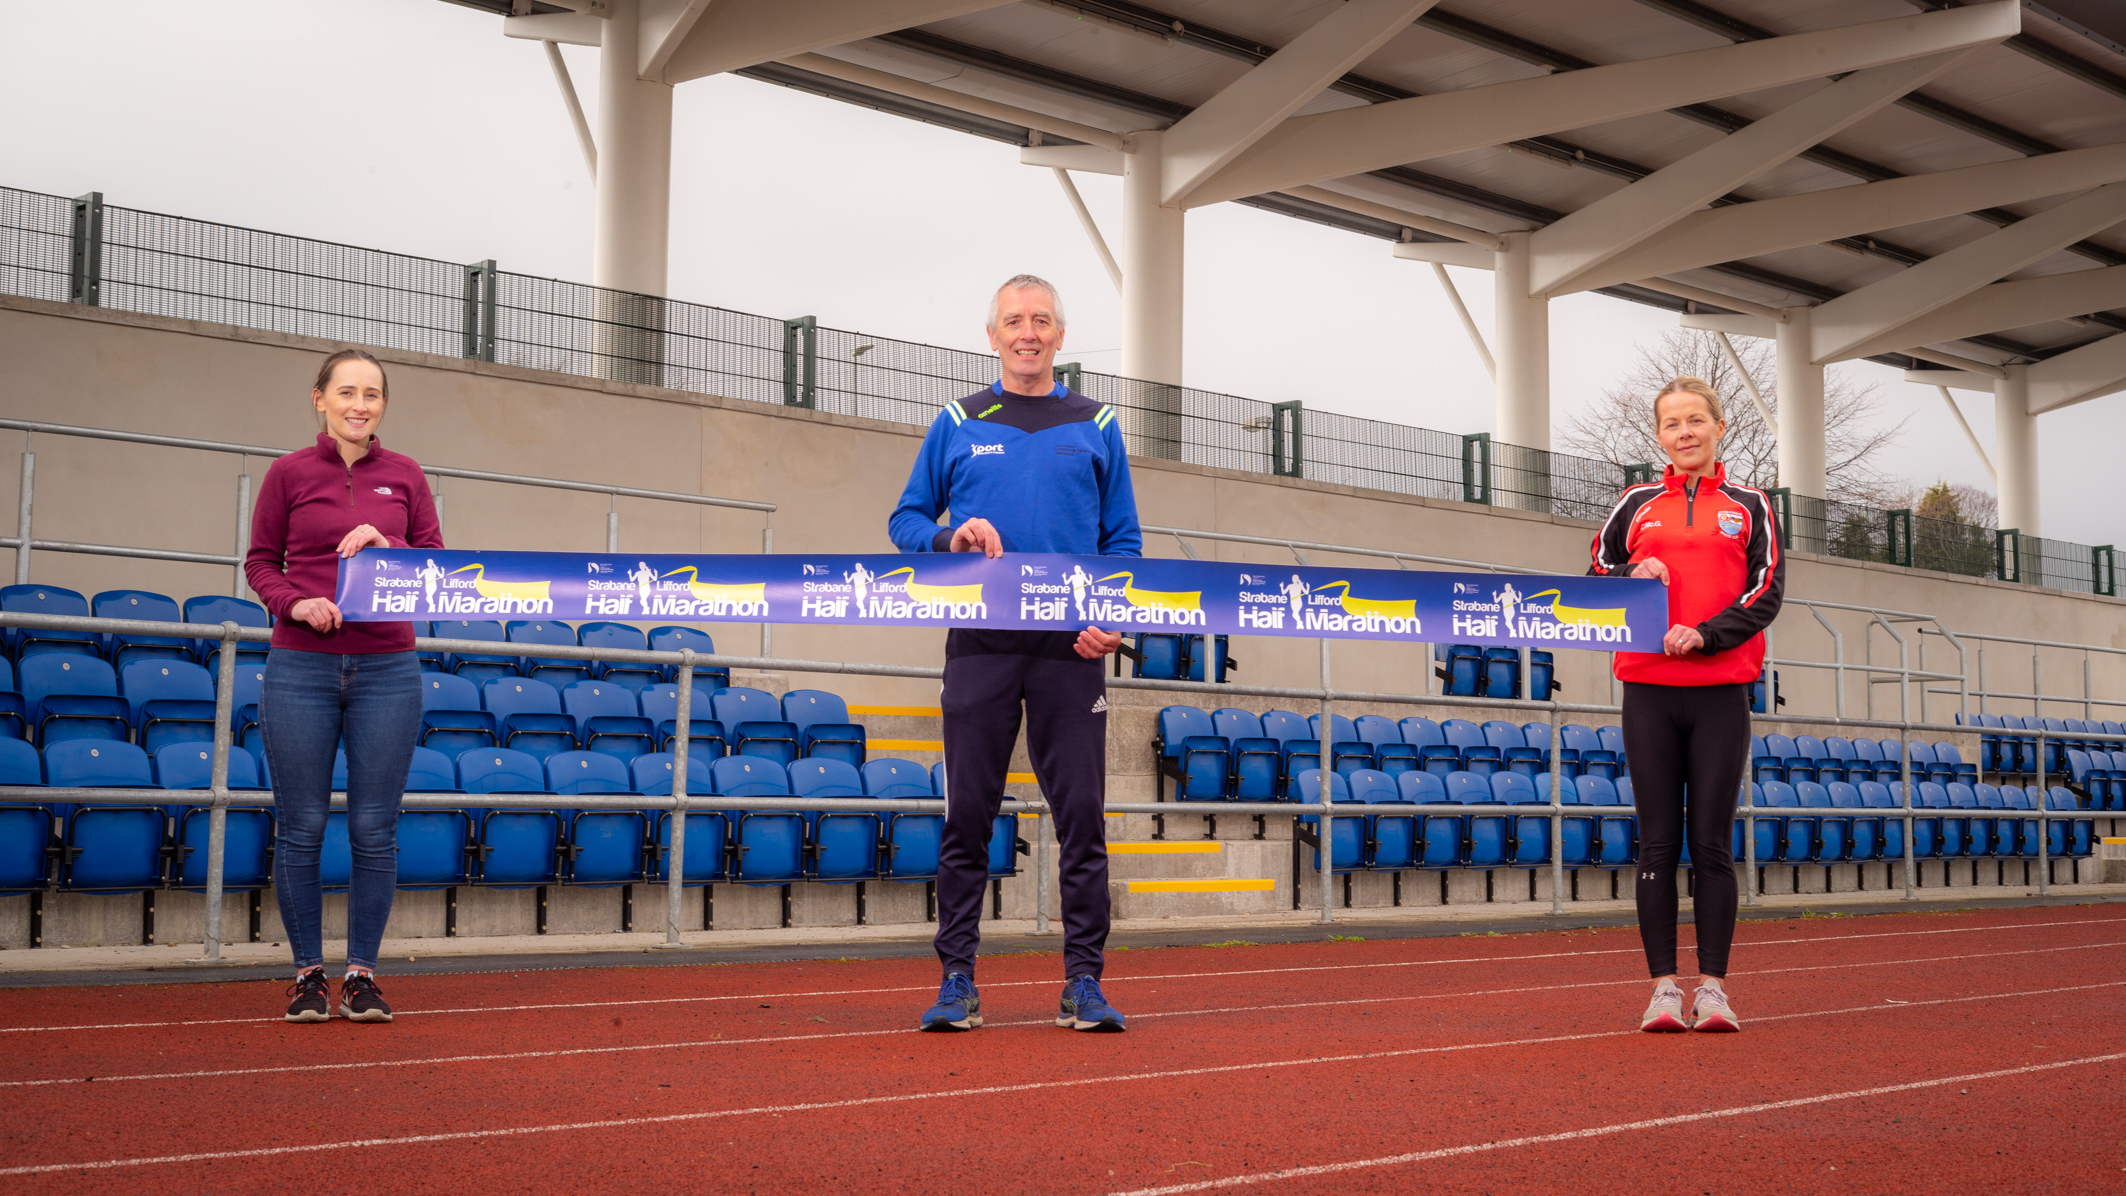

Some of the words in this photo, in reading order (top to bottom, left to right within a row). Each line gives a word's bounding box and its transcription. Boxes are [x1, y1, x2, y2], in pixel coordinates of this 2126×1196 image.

[375, 576, 422, 587] Strabane
[442, 577, 477, 589] Lifford
[588, 578, 637, 592] Strabane
[656, 579, 691, 593] Lifford
[803, 580, 852, 593] Strabane
[873, 582, 907, 593] Lifford
[1022, 581, 1071, 593] Strabane
[1091, 585, 1126, 597] Lifford
[372, 591, 419, 612] Half
[438, 591, 553, 613] Marathon
[585, 594, 633, 614] Half
[652, 594, 769, 616] Marathon
[801, 596, 849, 617] Half
[869, 595, 987, 619] Marathon
[1240, 590, 1288, 603] Strabane
[1307, 593, 1341, 605] Lifford
[1453, 599, 1500, 612] Strabane
[1521, 604, 1553, 614] Lifford
[1021, 597, 1067, 620] Half
[1089, 599, 1206, 625] Marathon
[1239, 606, 1285, 628] Half
[1306, 609, 1421, 634] Marathon
[1453, 615, 1498, 636] Half
[1519, 617, 1631, 642] Marathon
